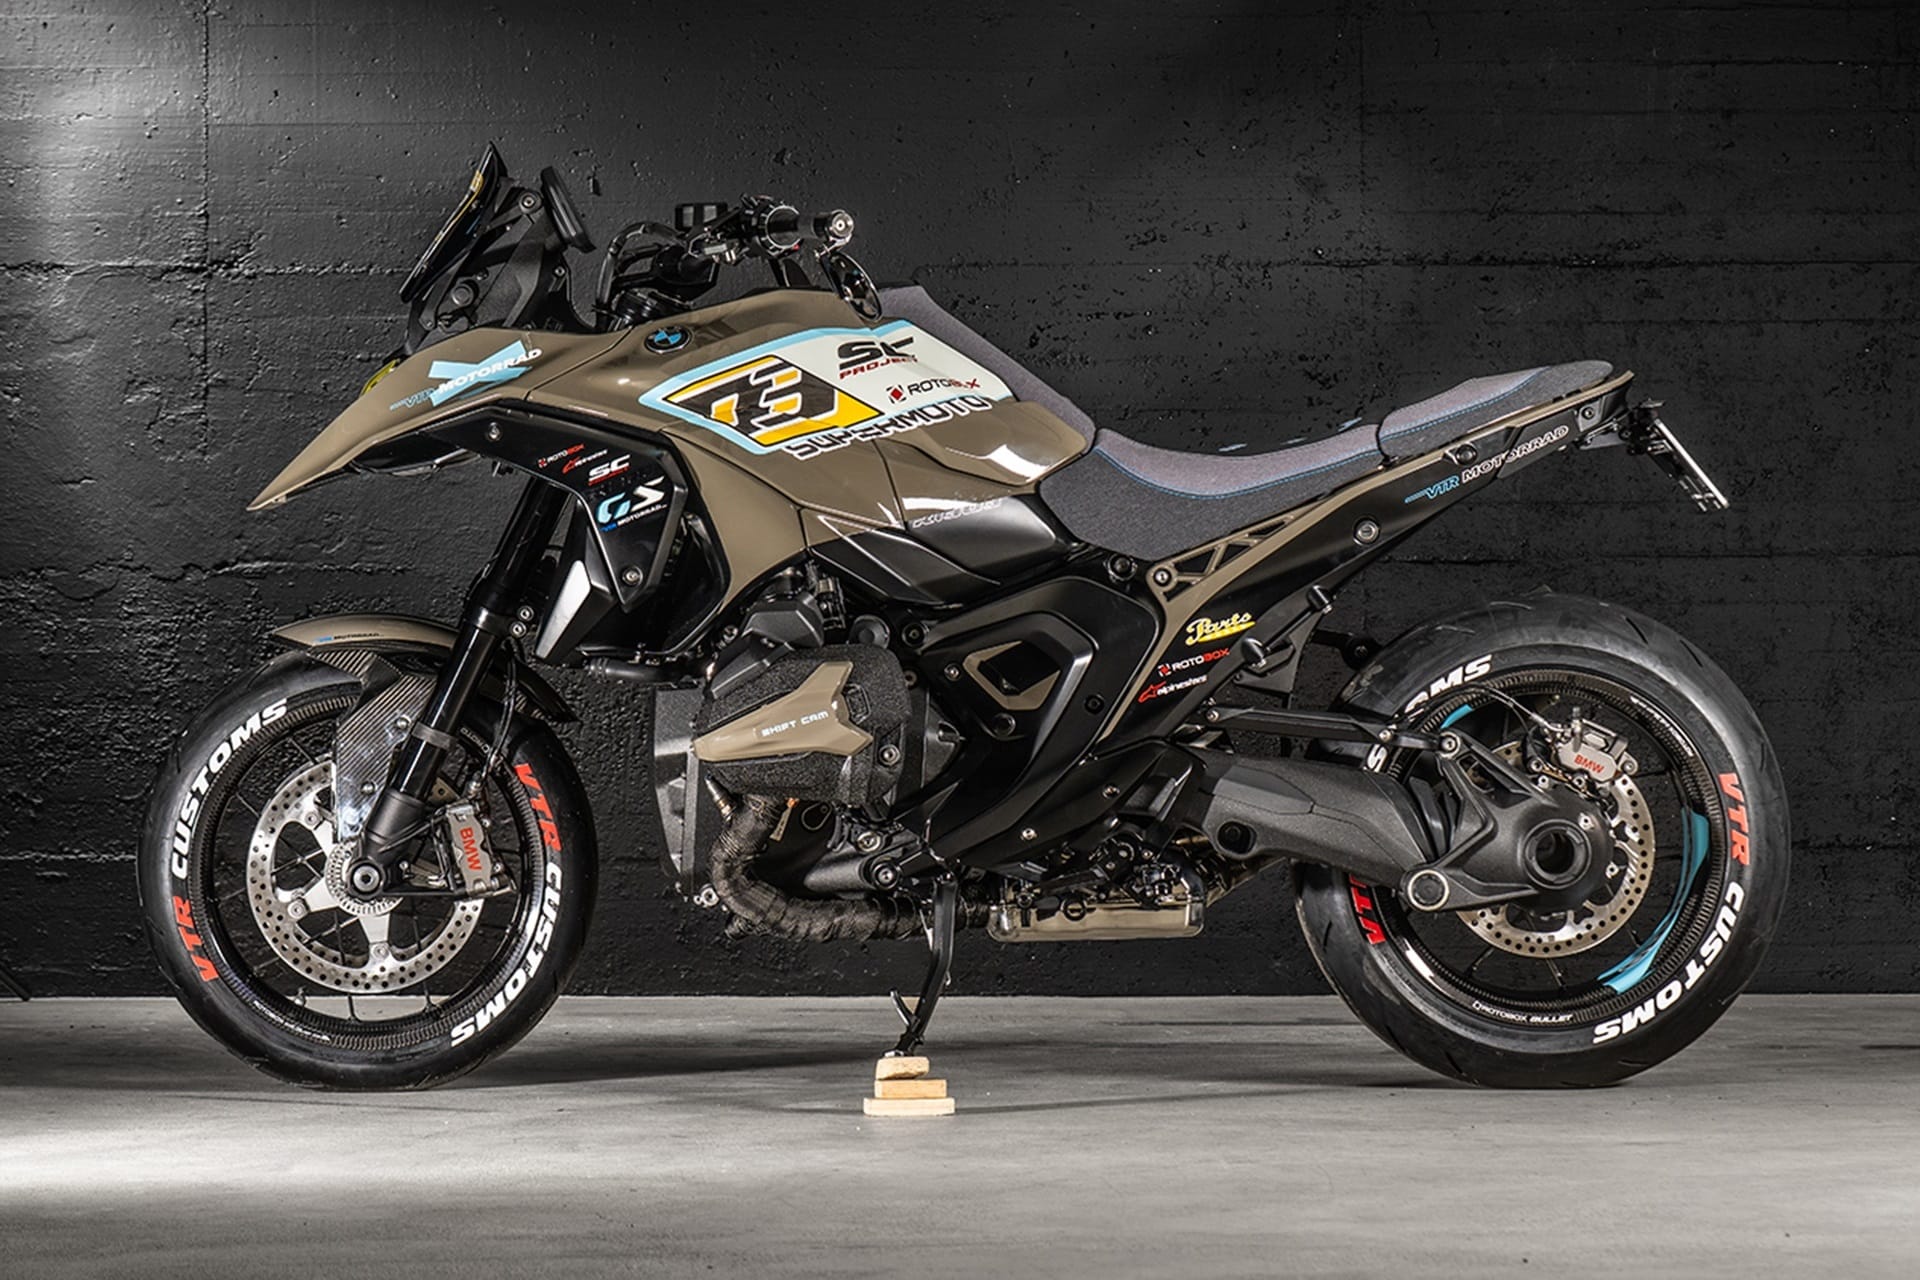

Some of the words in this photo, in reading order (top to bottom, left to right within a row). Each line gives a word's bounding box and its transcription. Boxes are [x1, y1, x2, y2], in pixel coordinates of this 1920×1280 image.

[438, 349, 542, 393] MOTORRAD
[907, 378, 981, 396] ROTOBX
[784, 394, 992, 459] SUPERMOTO
[1425, 475, 1460, 499] VTR
[1461, 425, 1569, 483] MOTORRAD
[1172, 648, 1230, 671] ROTOBOX
[172, 698, 287, 879] CUSTOMS
[1574, 754, 1605, 773] BMW
[514, 763, 562, 851] VTR
[1718, 772, 1750, 866] VTR
[460, 827, 482, 870] BMW
[173, 895, 219, 982] VTR
[451, 862, 562, 1047] CUSTOMS
[1593, 881, 1745, 1044] CUSTOMS
